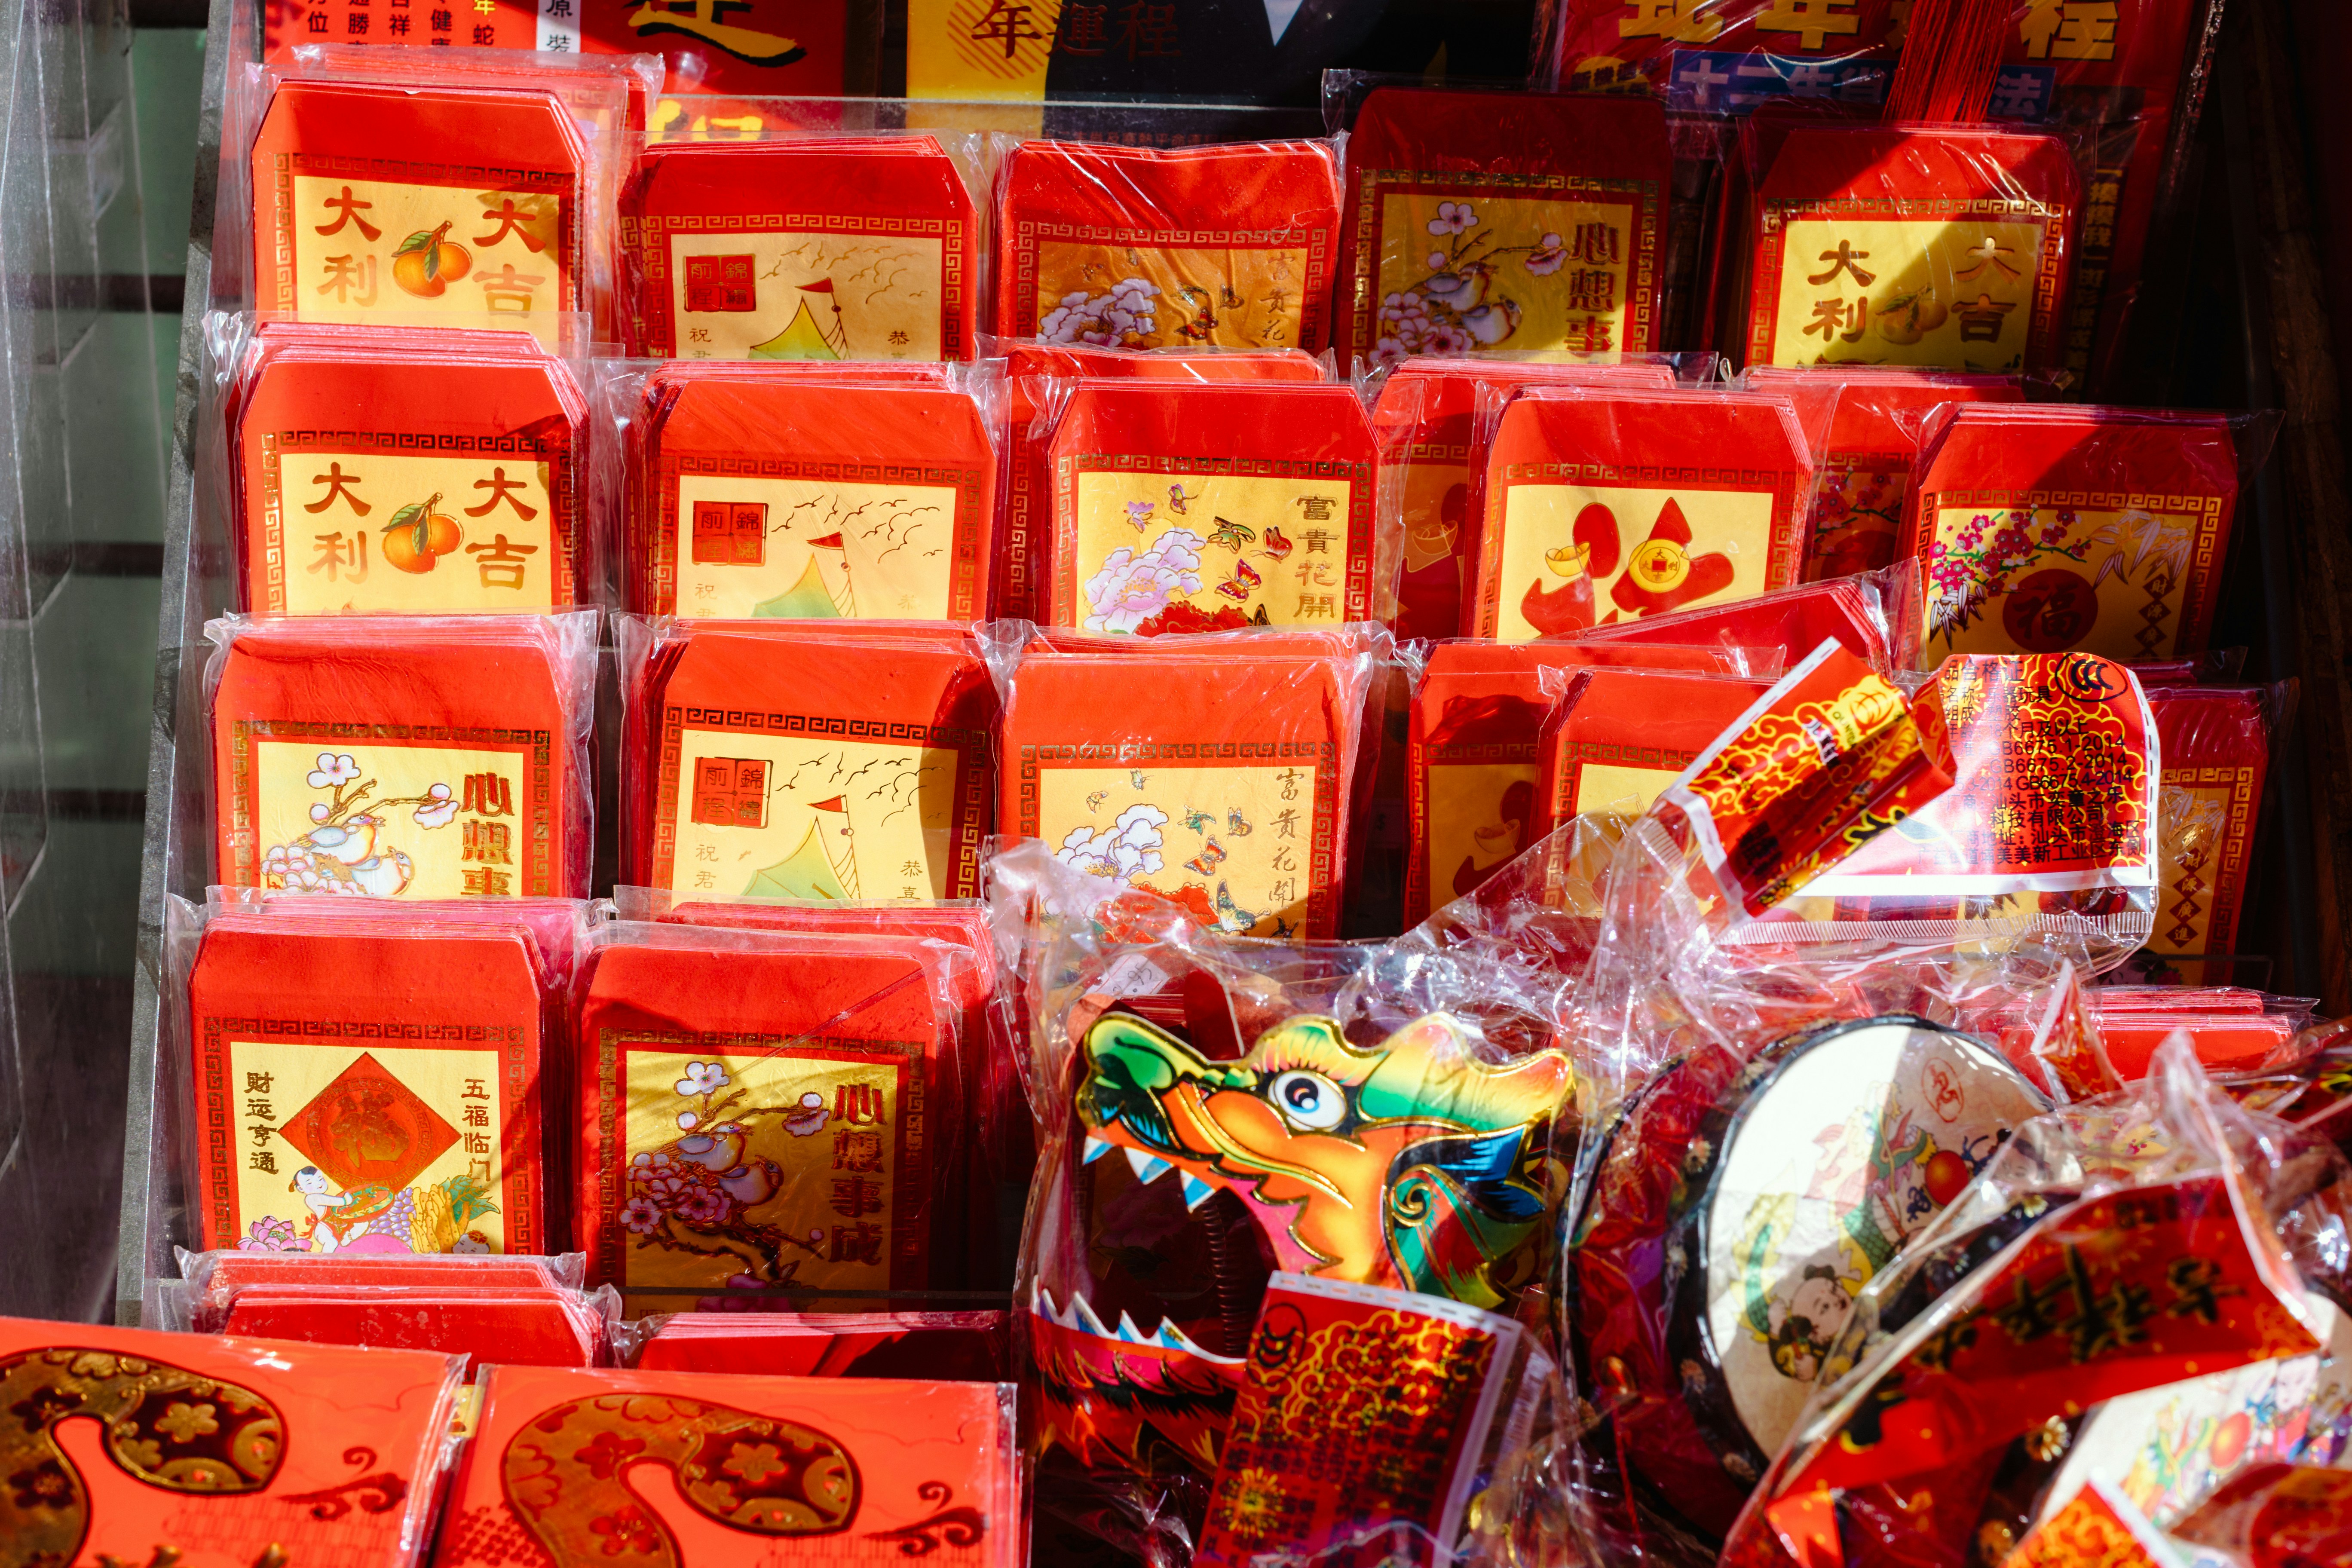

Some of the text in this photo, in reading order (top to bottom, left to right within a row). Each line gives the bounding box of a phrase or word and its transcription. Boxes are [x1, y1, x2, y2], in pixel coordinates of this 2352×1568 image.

[307, 0, 329, 33] 位
[315, 186, 382, 307] 大利
[473, 199, 546, 318] 大吉
[1803, 239, 1877, 343] 大利
[1951, 236, 2021, 343] 大吉
[304, 462, 371, 584] 大利
[464, 467, 538, 590] 大吉
[1293, 493, 1341, 619] 富貴花開
[1990, 753, 2128, 774] GB6675.2-2014
[1990, 805, 2103, 830] 科技有限公司
[460, 772, 515, 895] 心想事
[1268, 768, 1305, 907] 富貴花開
[244, 1071, 280, 1175] 財运亨通
[461, 1078, 491, 1183] 五福临门
[829, 1082, 888, 1266] 心想事成
